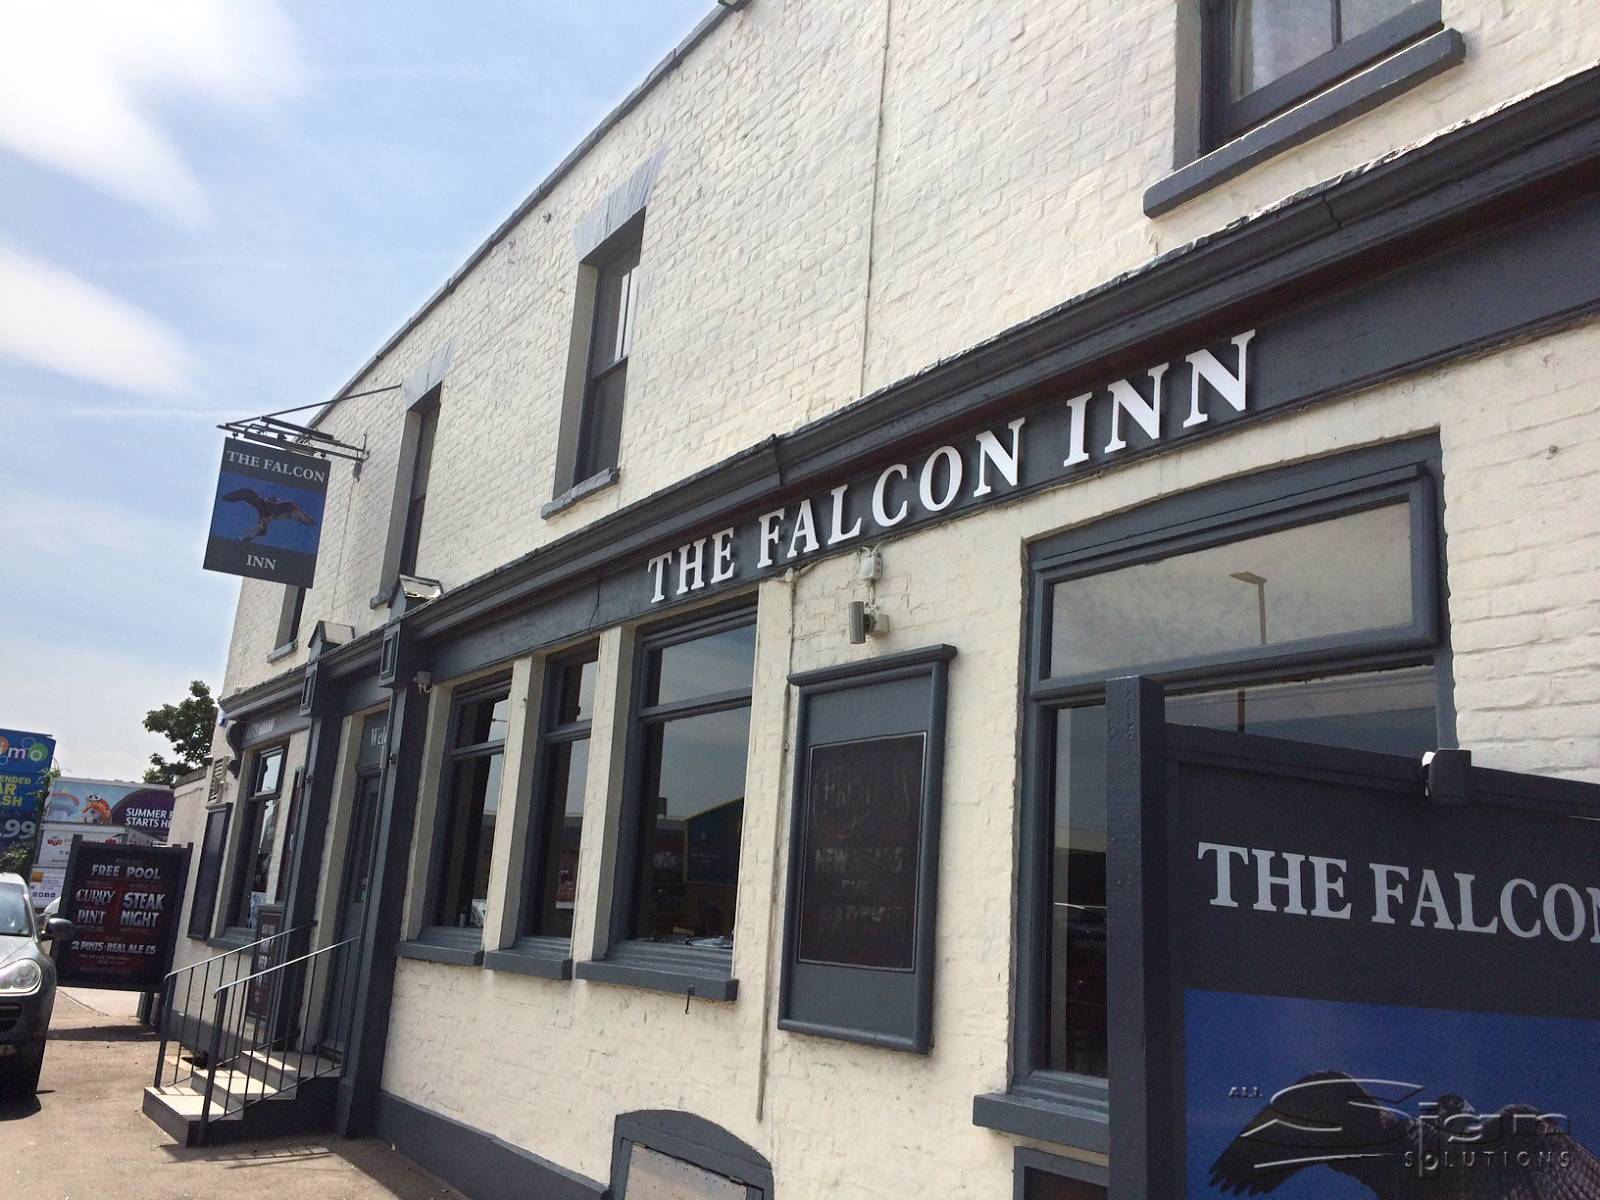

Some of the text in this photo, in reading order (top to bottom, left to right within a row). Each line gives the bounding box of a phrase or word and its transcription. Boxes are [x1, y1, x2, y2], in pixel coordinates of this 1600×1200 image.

[227, 450, 326, 483] THE FALCON
[646, 329, 1256, 604] THE FALCON INN
[246, 554, 278, 571] INN
[125, 807, 167, 819] SUMMER
[125, 817, 159, 828] STARTS
[91, 864, 161, 880] FREE POOL
[1197, 842, 1352, 920] THE
[76, 888, 116, 906] CURRY
[123, 891, 166, 911] STEAK
[76, 909, 106, 924] PINT
[120, 910, 160, 928] NIGHT
[70, 940, 80, 950] 2
[80, 941, 104, 952] PINTS
[106, 942, 127, 953] REAL
[127, 944, 144, 954] ALE
